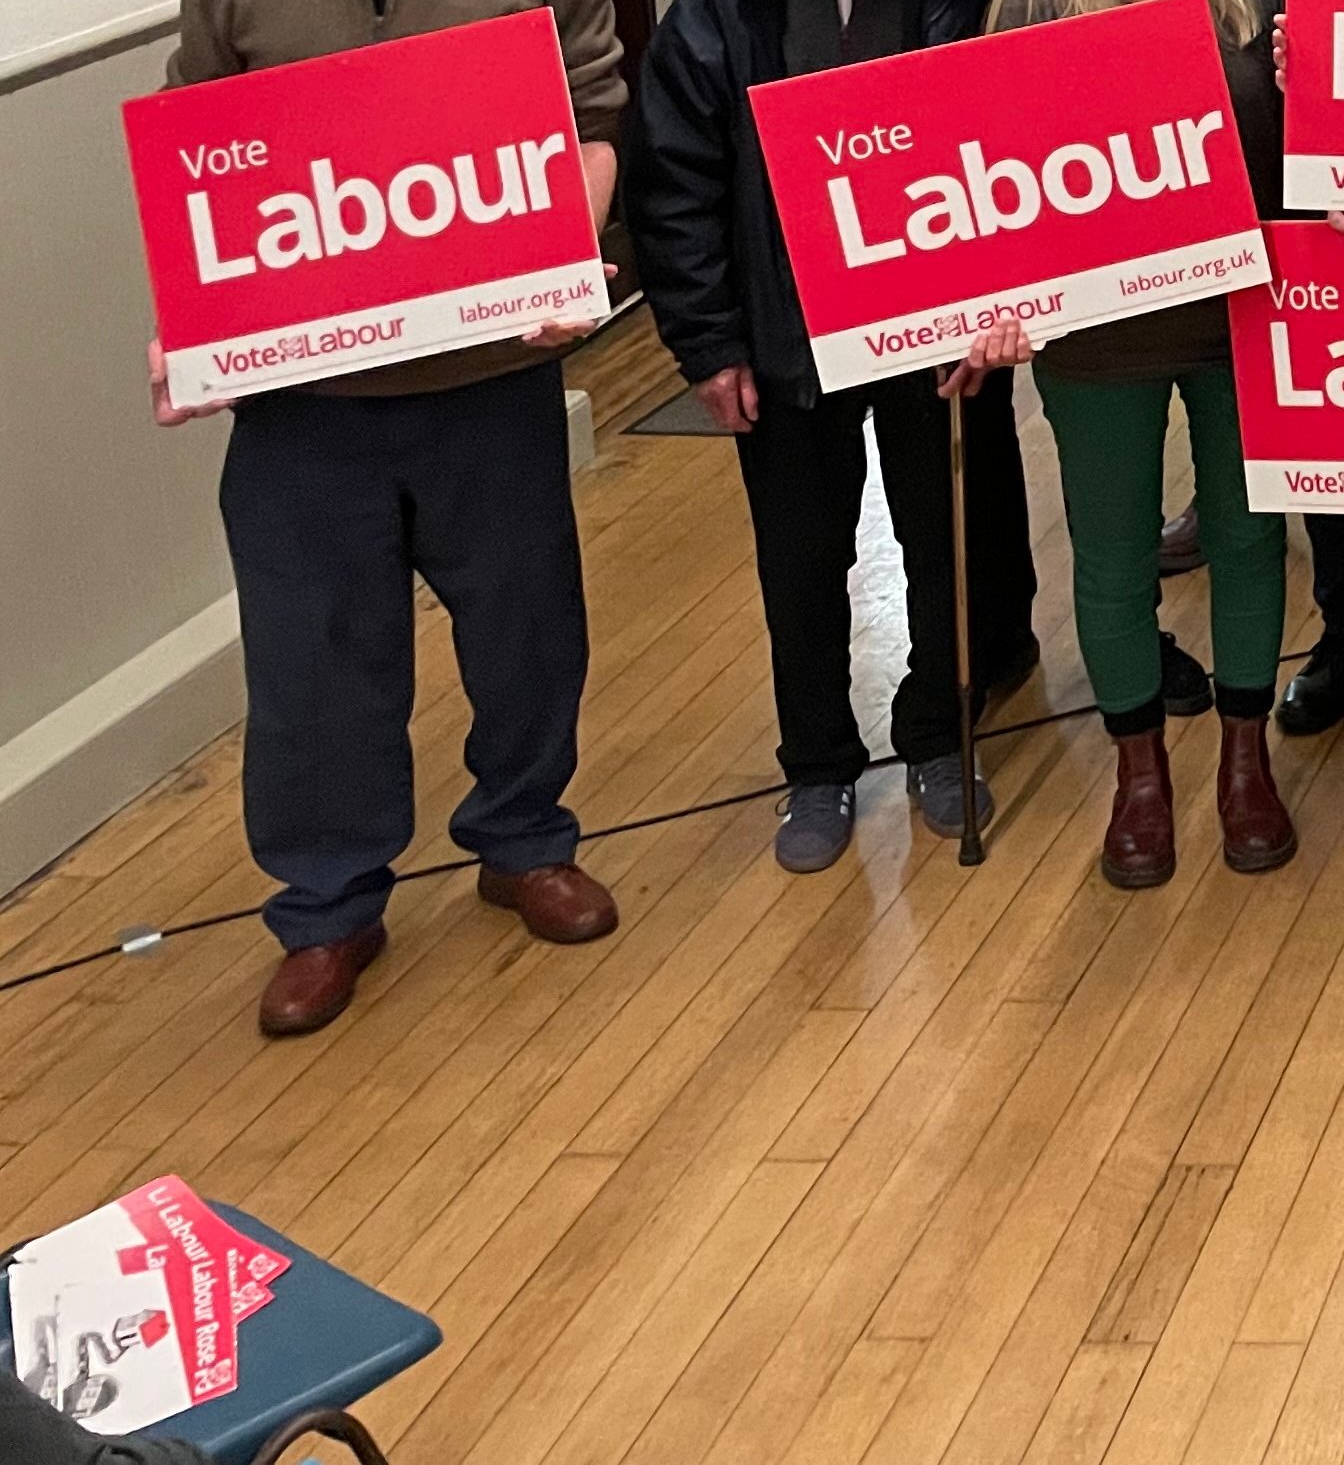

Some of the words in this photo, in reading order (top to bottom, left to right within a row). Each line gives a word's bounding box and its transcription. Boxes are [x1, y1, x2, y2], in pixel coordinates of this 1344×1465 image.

[179, 139, 269, 180] Vote
[816, 122, 914, 166] Vote
[186, 133, 566, 285] Labour
[827, 110, 1224, 269] Labour
[1120, 249, 1256, 297] labour.org.uk
[458, 279, 595, 324] labour.org.uk
[1268, 281, 1340, 311] Vote
[213, 342, 280, 376] Vote
[304, 317, 406, 359] Labour
[865, 325, 935, 357] Vote
[1284, 471, 1339, 495] Vote
[191, 1260, 218, 1321] Labour
